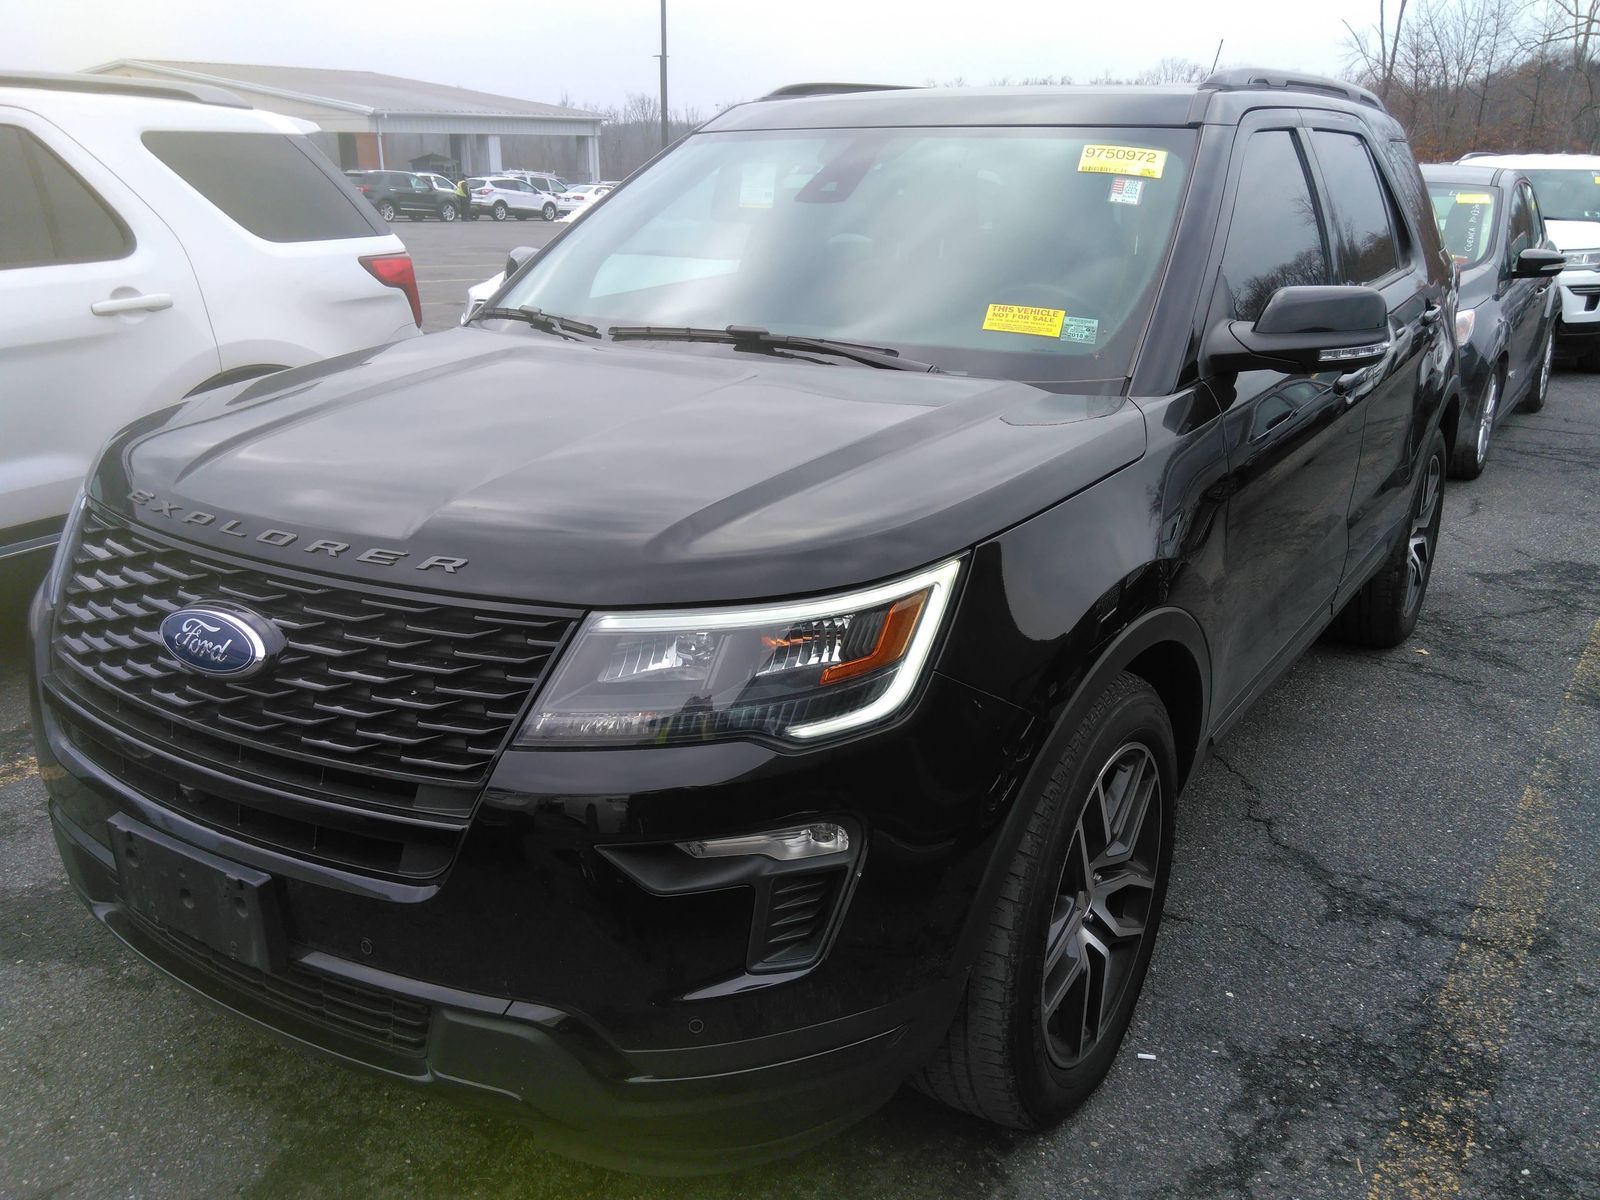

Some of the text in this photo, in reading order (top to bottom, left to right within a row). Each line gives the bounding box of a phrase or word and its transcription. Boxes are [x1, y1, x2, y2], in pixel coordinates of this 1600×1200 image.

[1085, 147, 1157, 164] 9750972
[992, 305, 1060, 318] THIS VEHICLE
[1012, 313, 1030, 321] FOR
[1032, 316, 1056, 324] SALE
[127, 488, 469, 574] EXPLORER
[174, 618, 233, 662] Ford
